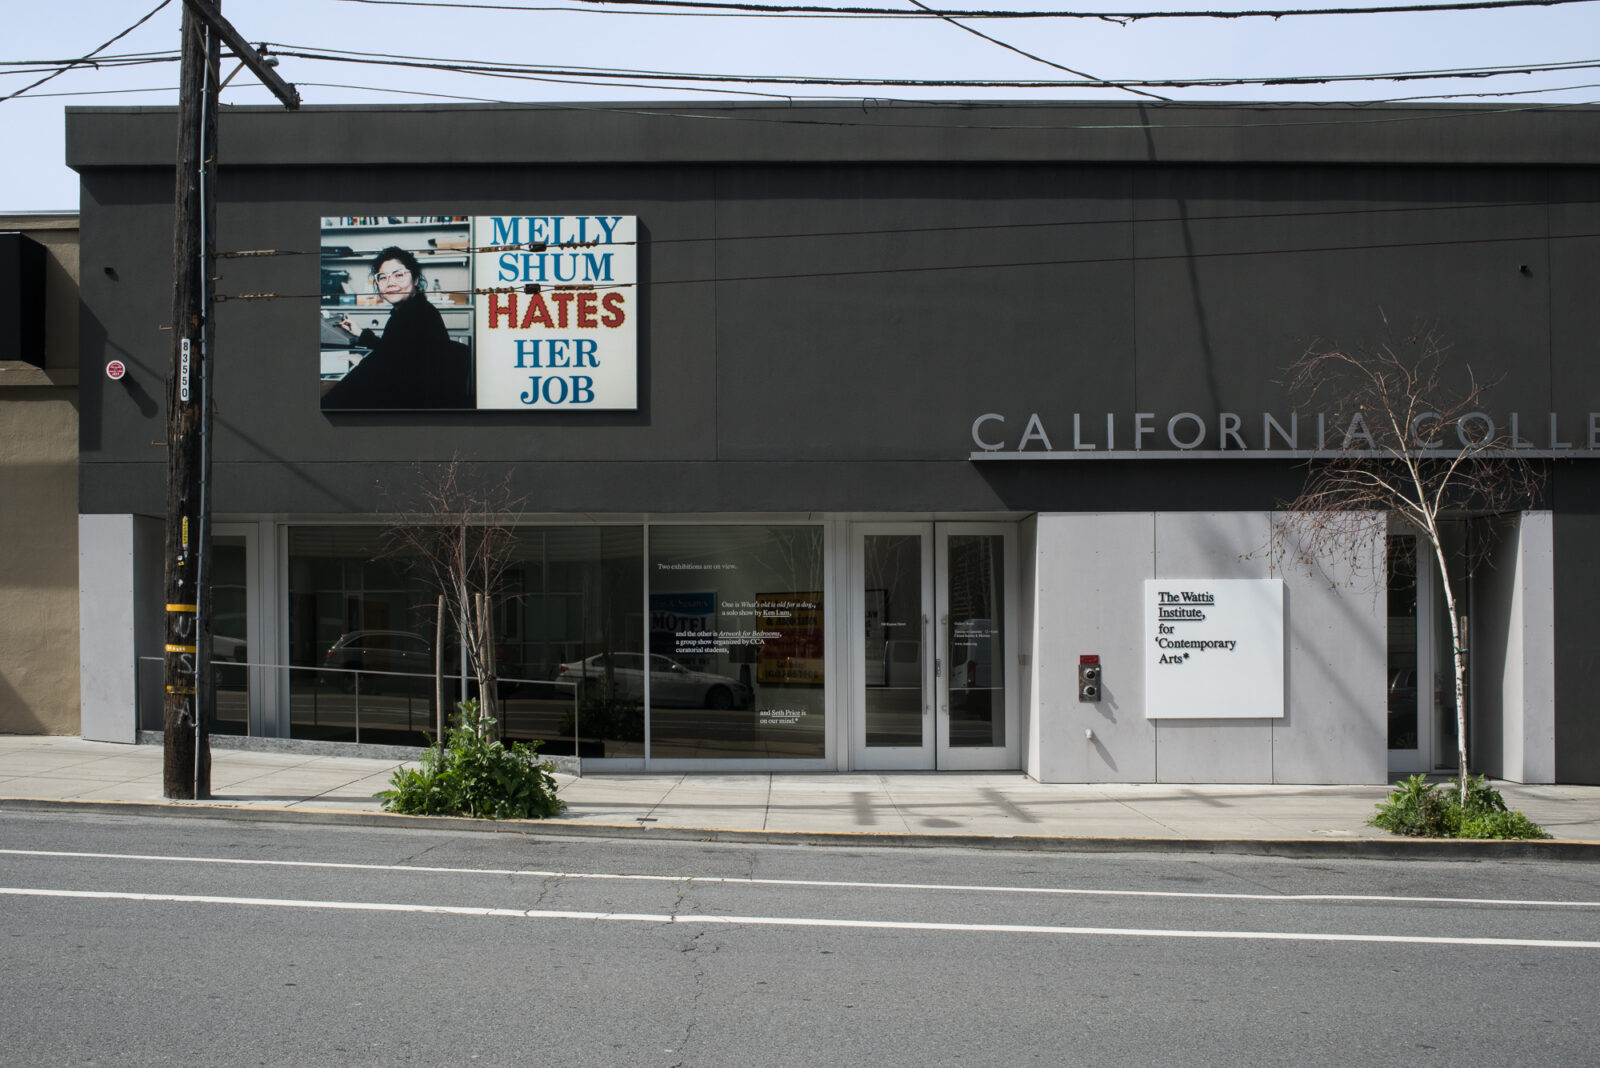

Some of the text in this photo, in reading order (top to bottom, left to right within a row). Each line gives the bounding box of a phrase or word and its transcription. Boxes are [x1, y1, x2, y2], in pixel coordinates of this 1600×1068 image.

[490, 216, 623, 246] MELLY
[498, 252, 615, 282] SHUM
[488, 292, 626, 329] HATES
[513, 339, 601, 369] HER
[520, 375, 595, 405] JOB
[971, 411, 1377, 450] CALIFORNIA
[1158, 592, 1214, 603] The Wattis
[1158, 607, 1205, 620] Institute,
[743, 631, 751, 639] for
[1158, 624, 1174, 634] for
